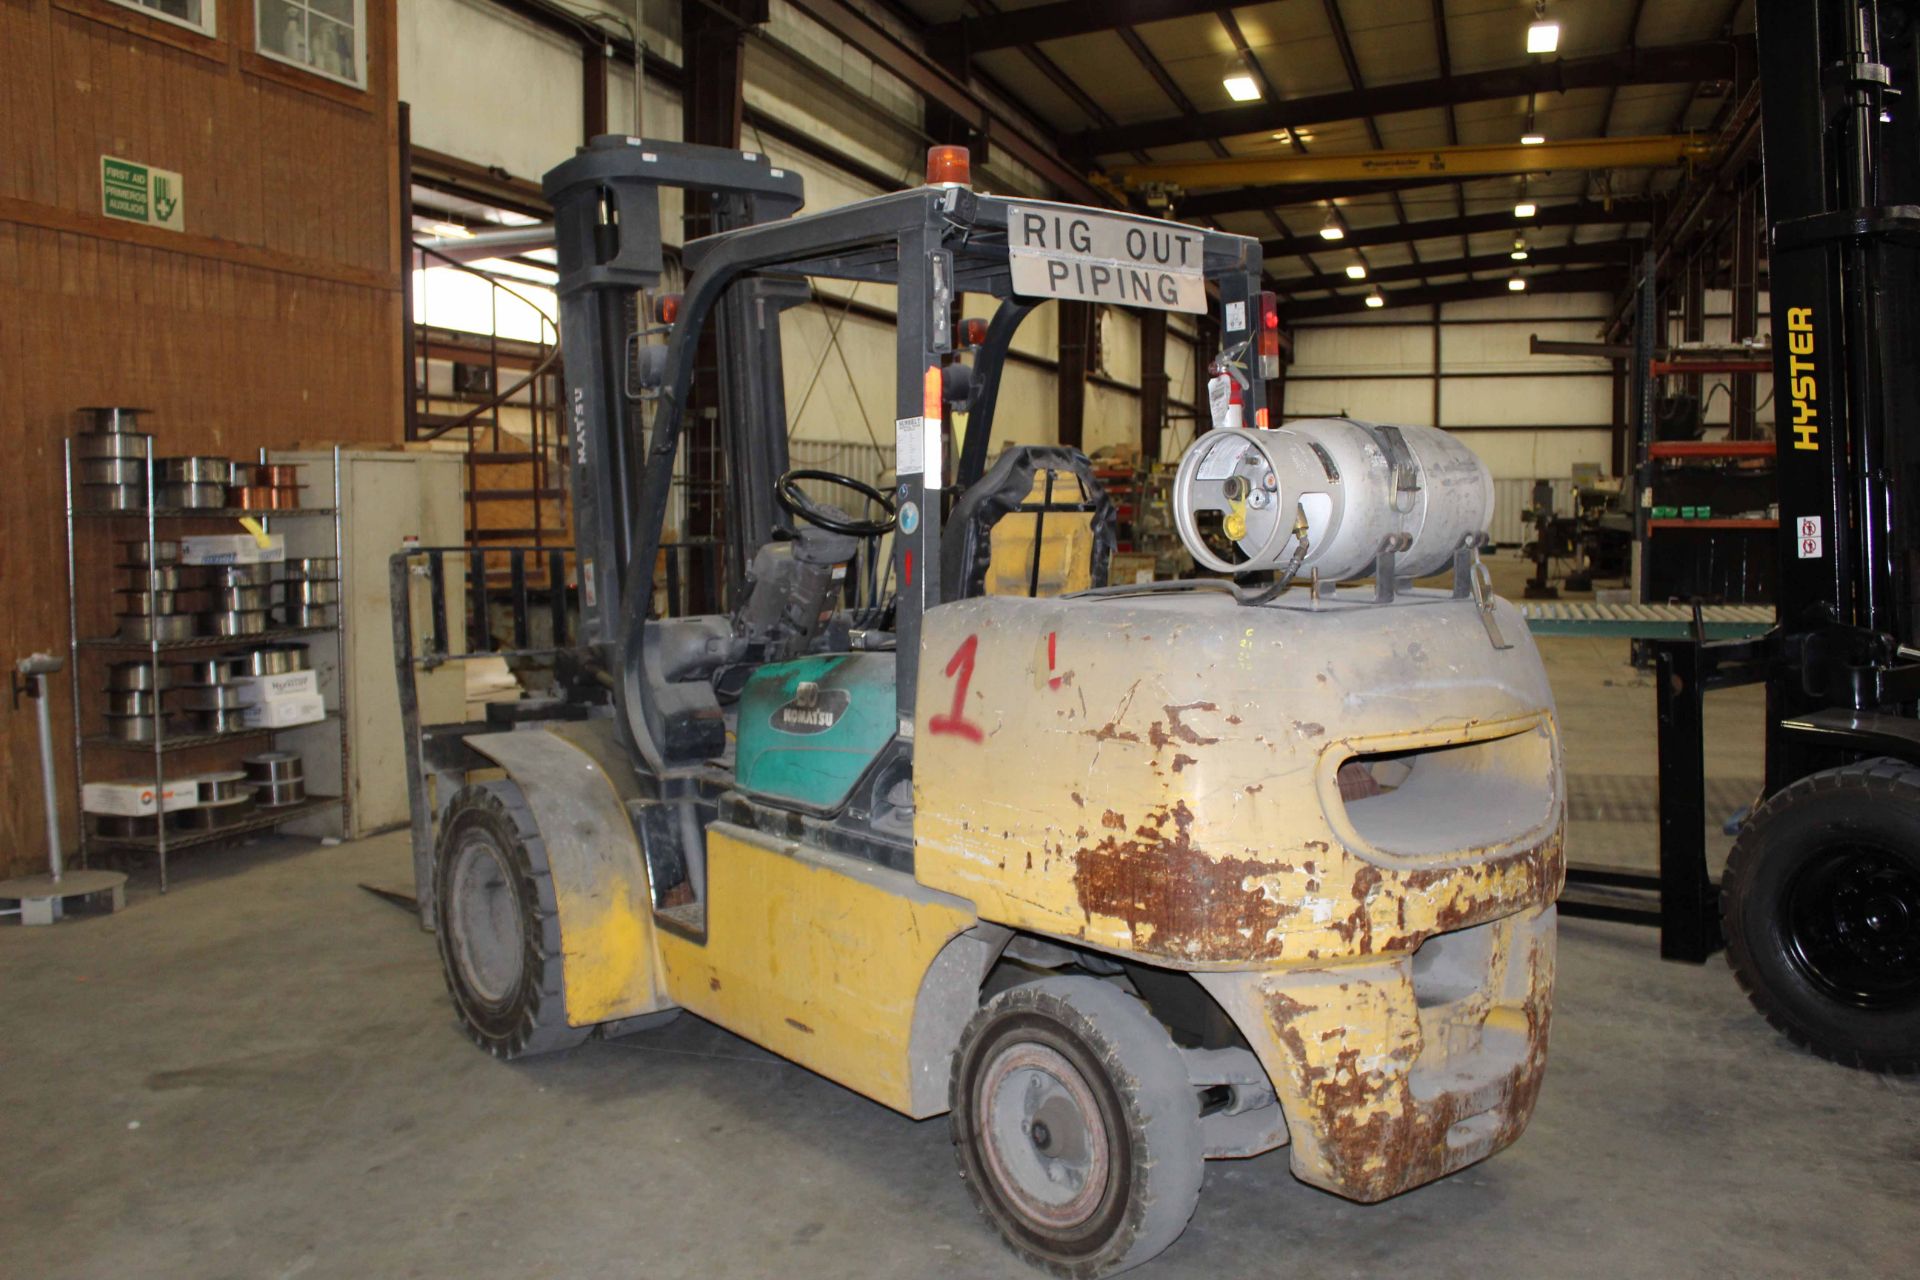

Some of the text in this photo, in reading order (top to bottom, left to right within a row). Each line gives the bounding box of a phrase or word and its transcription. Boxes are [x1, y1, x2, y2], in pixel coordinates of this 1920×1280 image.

[106, 166, 146, 185] FIRST AID
[105, 185, 147, 204] PRIMEROS
[109, 198, 146, 215] AUXILIOS
[1023, 213, 1191, 266] RIG OUT
[1047, 260, 1179, 305] PIPING
[1787, 306, 1819, 451] HYSTER
[783, 707, 834, 727] KOMATSU
